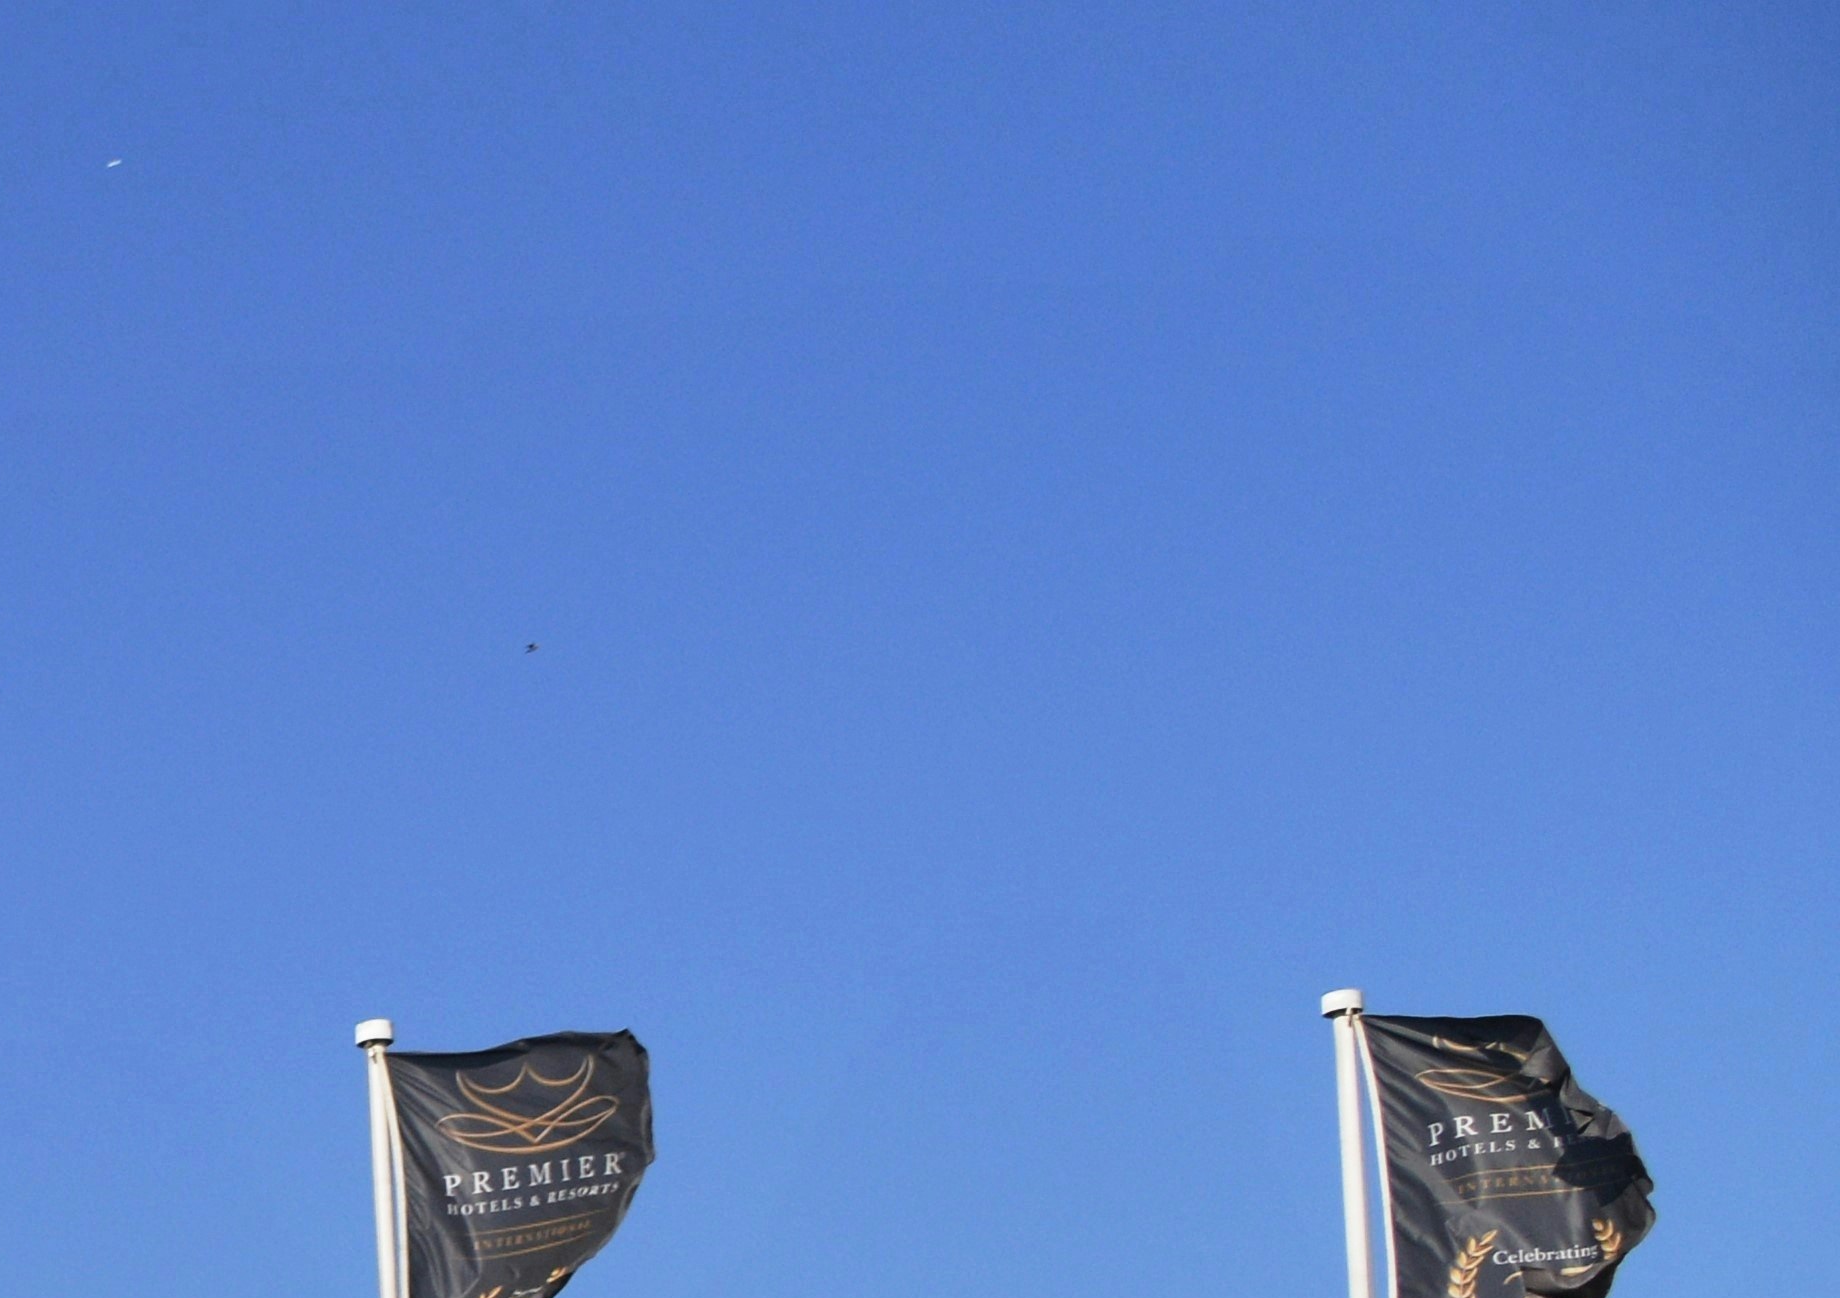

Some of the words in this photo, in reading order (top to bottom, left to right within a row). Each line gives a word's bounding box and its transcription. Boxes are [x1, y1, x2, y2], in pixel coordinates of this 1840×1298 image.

[1431, 1139, 1516, 1166] HOTELS
[1528, 1139, 1541, 1150] &
[443, 1152, 623, 1197] PREMIER
[447, 1197, 522, 1216] HOTELS
[529, 1195, 540, 1207] &
[547, 1181, 621, 1204] RESORTS
